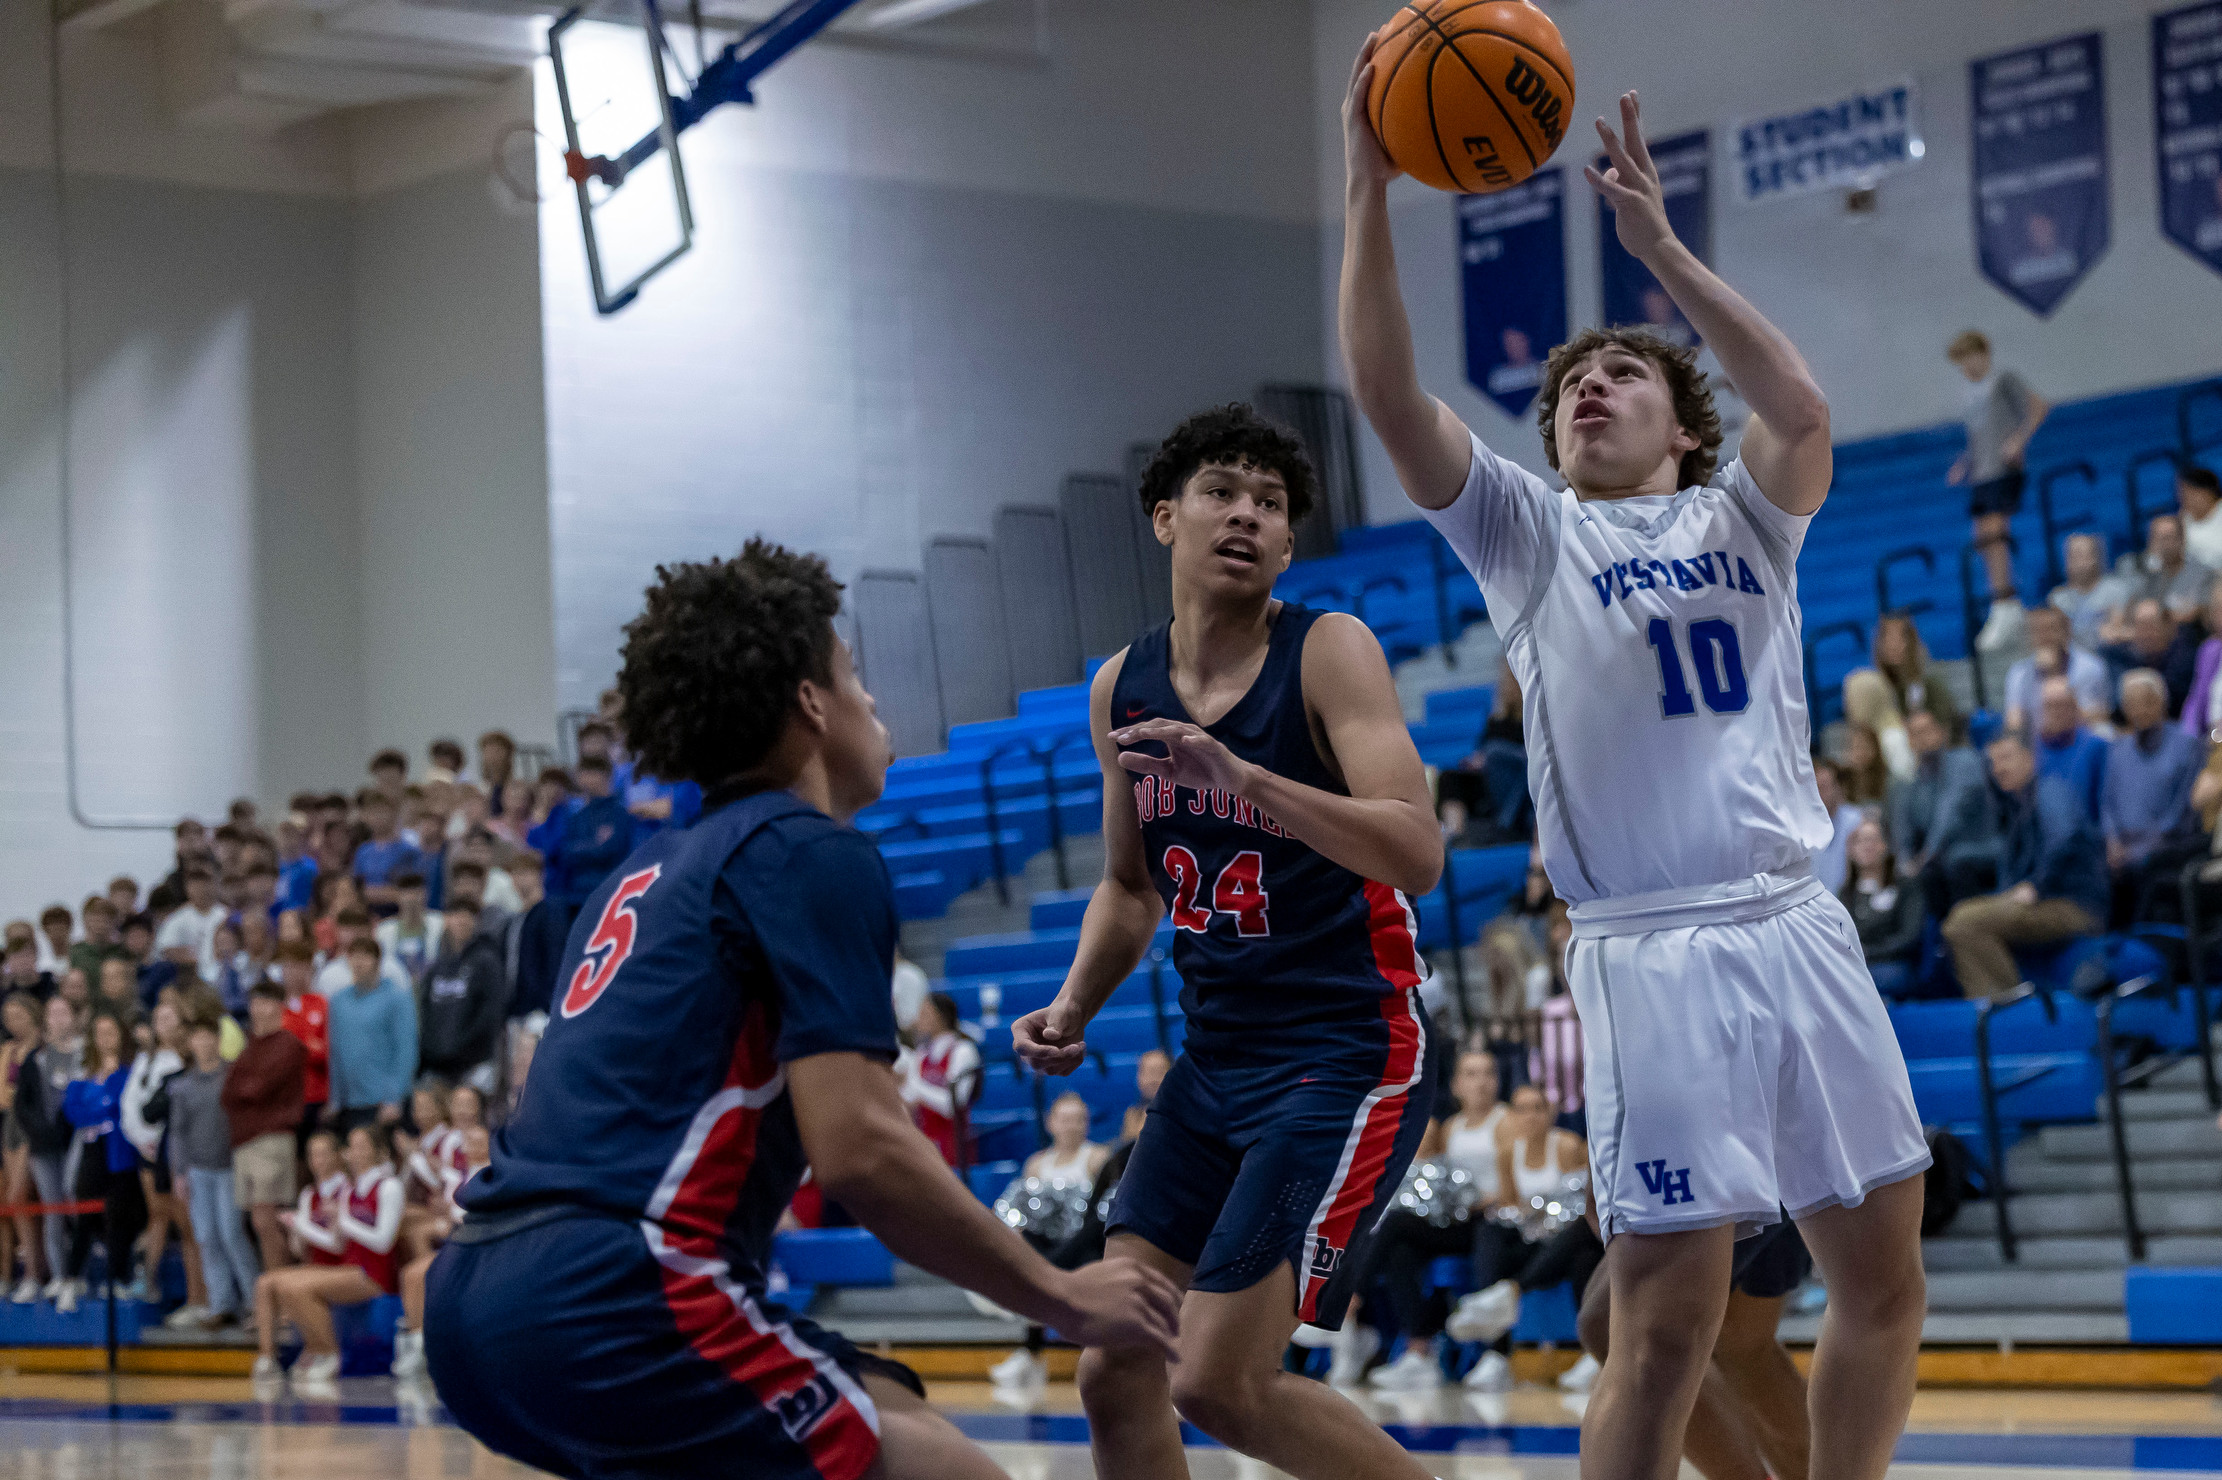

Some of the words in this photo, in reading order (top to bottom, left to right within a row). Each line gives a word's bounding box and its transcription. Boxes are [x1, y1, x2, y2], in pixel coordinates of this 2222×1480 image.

[1740, 86, 1907, 160] STUDENT
[1745, 130, 1905, 197] SECTION
[1645, 614, 1754, 721] 10
[1163, 844, 1271, 938] 24
[561, 862, 663, 1019] 5
[1634, 1159, 1695, 1205] VH
